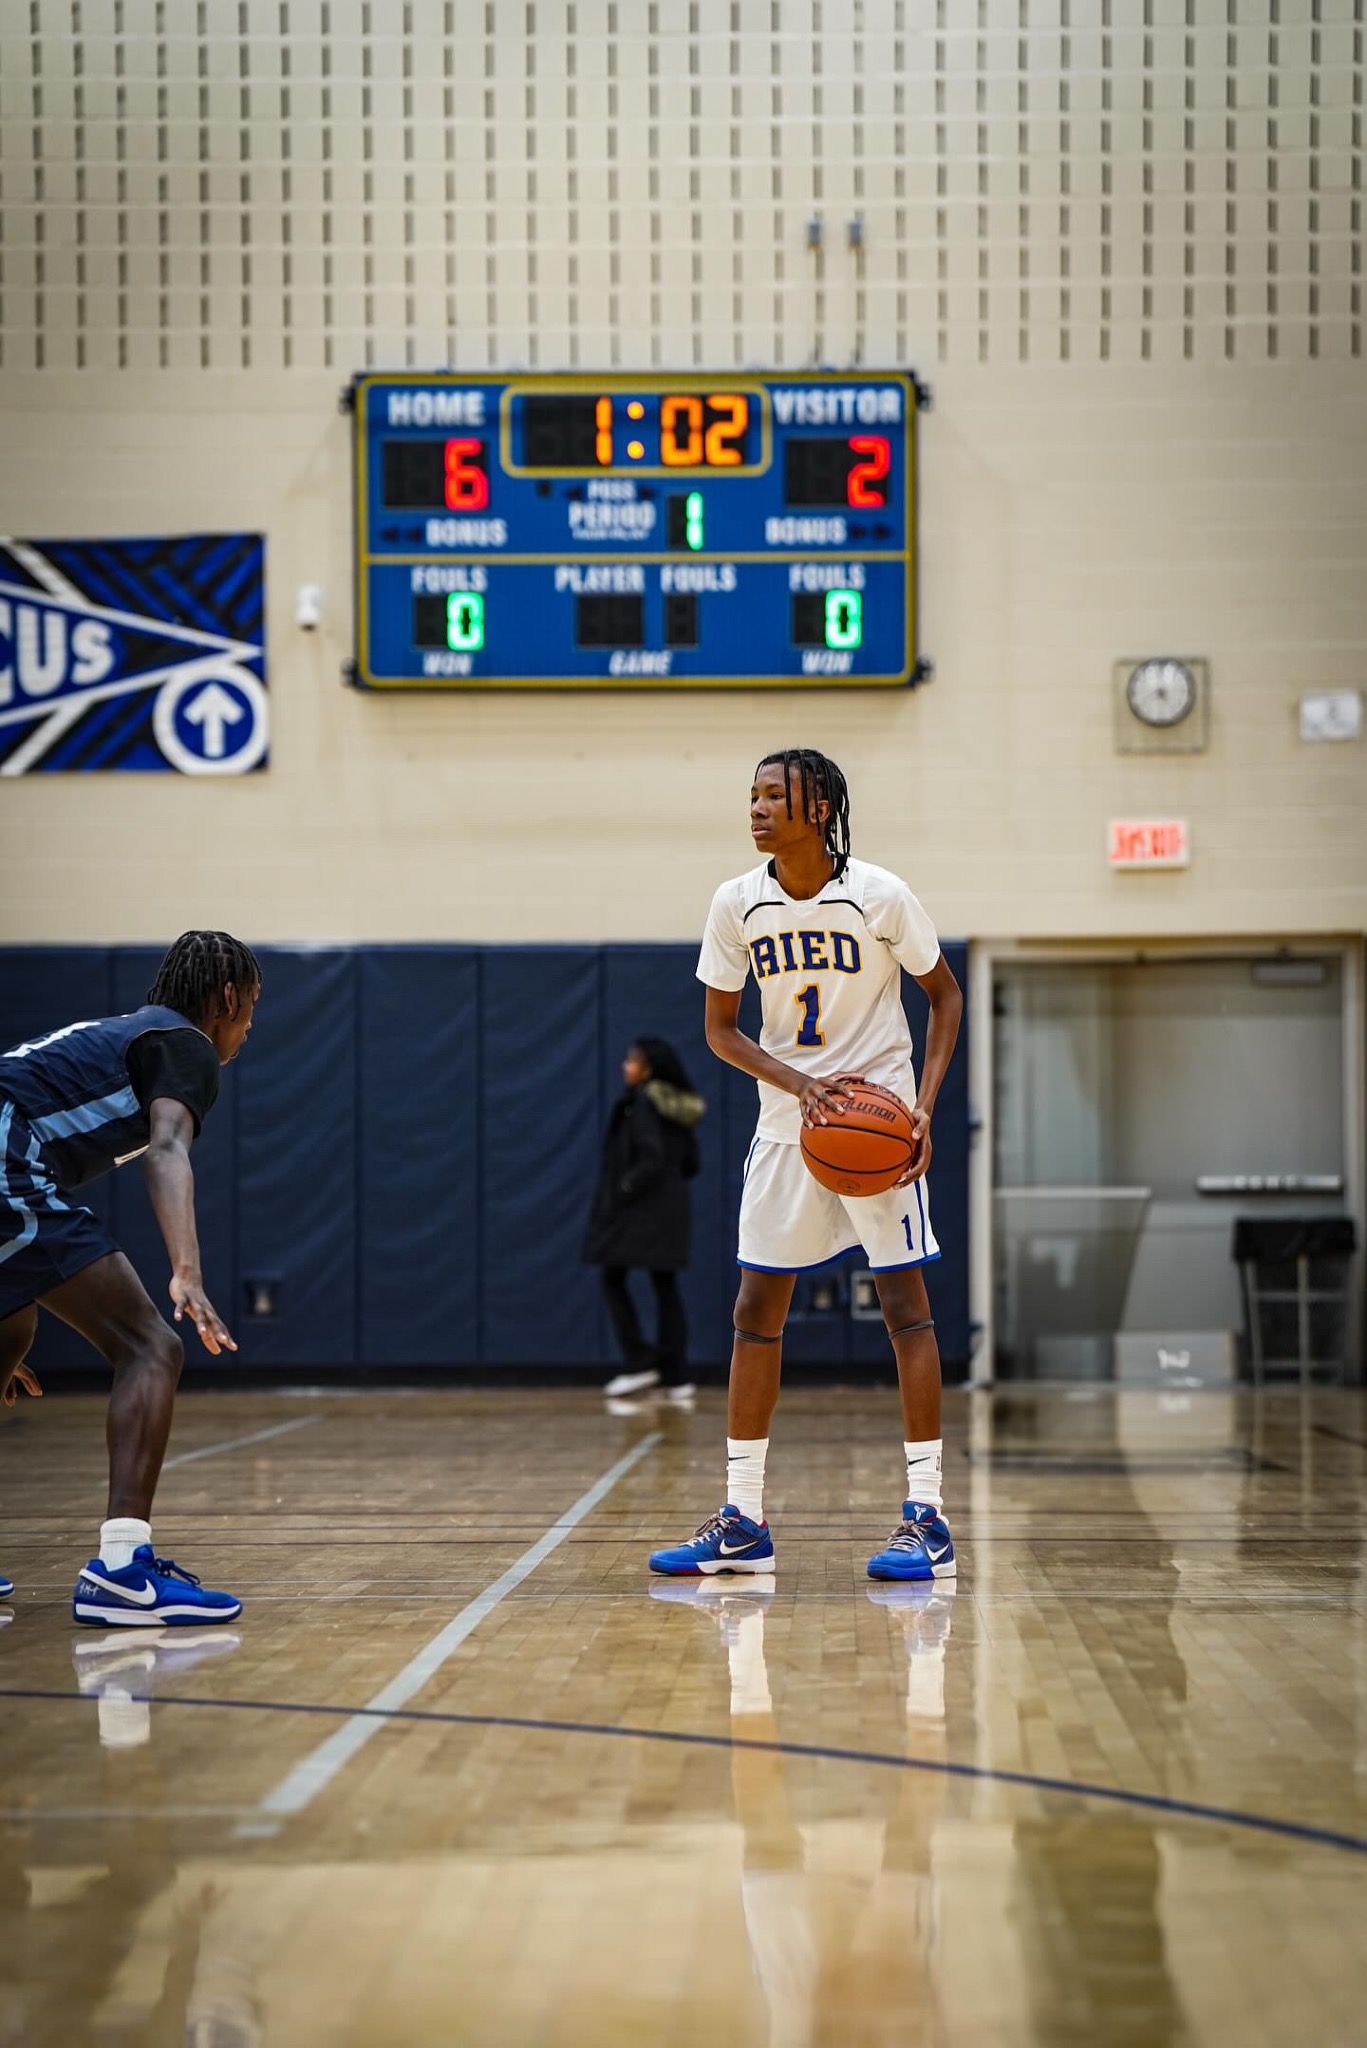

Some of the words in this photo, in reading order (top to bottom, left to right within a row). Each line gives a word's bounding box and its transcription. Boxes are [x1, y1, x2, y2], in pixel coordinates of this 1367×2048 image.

[388, 391, 485, 427] HOME
[773, 389, 901, 424] VISITOR
[596, 395, 748, 466] 1:02
[445, 437, 489, 511] 6
[848, 435, 890, 508] 2
[426, 519, 508, 547] BONUS
[569, 501, 656, 529] PERIOD
[686, 492, 703, 550] 1
[765, 517, 847, 545] BONUS
[411, 566, 488, 593] FOULS
[555, 565, 645, 592] PLAYER
[660, 564, 737, 592] FOULS
[789, 564, 866, 591] FOULS
[447, 591, 484, 651] 0
[825, 589, 861, 649] 0
[749, 930, 862, 979] RIED
[794, 982, 826, 1048] 1
[825, 1100, 897, 1122] OLUTION
[901, 1214, 914, 1250] 1
